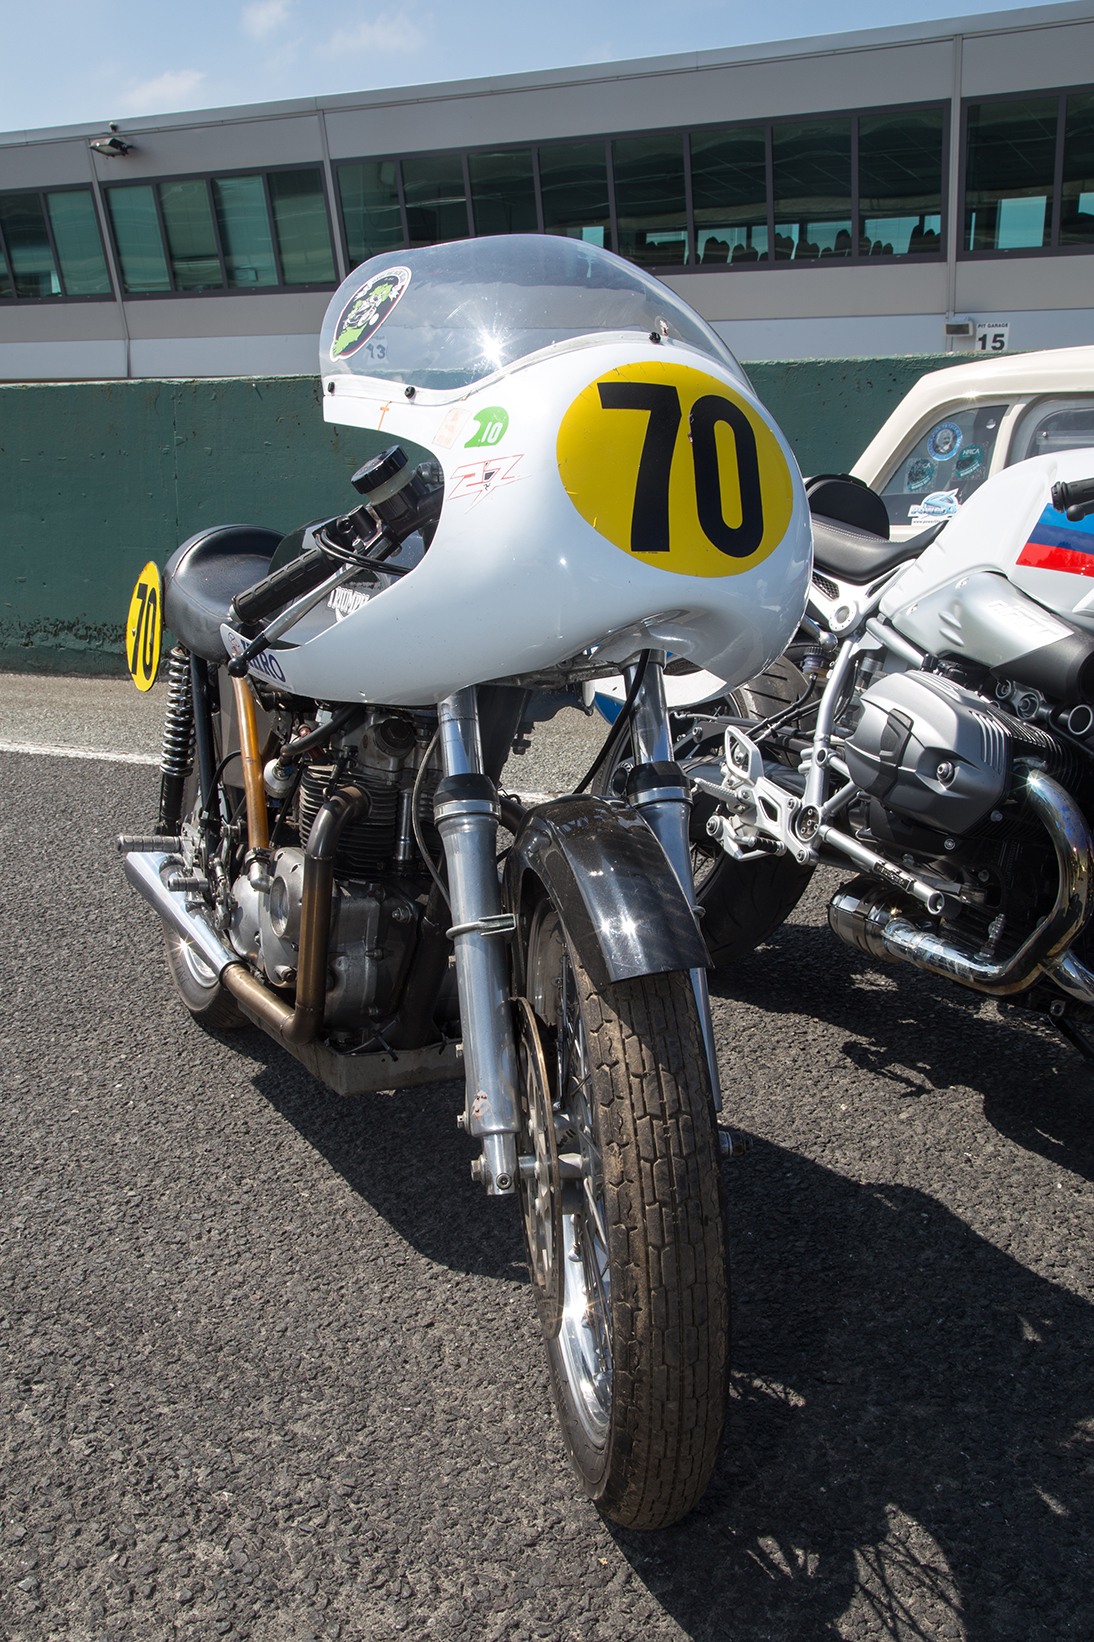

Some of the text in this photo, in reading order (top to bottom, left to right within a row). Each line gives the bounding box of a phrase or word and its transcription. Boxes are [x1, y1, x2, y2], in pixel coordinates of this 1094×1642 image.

[978, 333, 1005, 350] 15
[481, 421, 503, 443] 10
[597, 382, 764, 558] 70
[130, 582, 158, 680] 70
